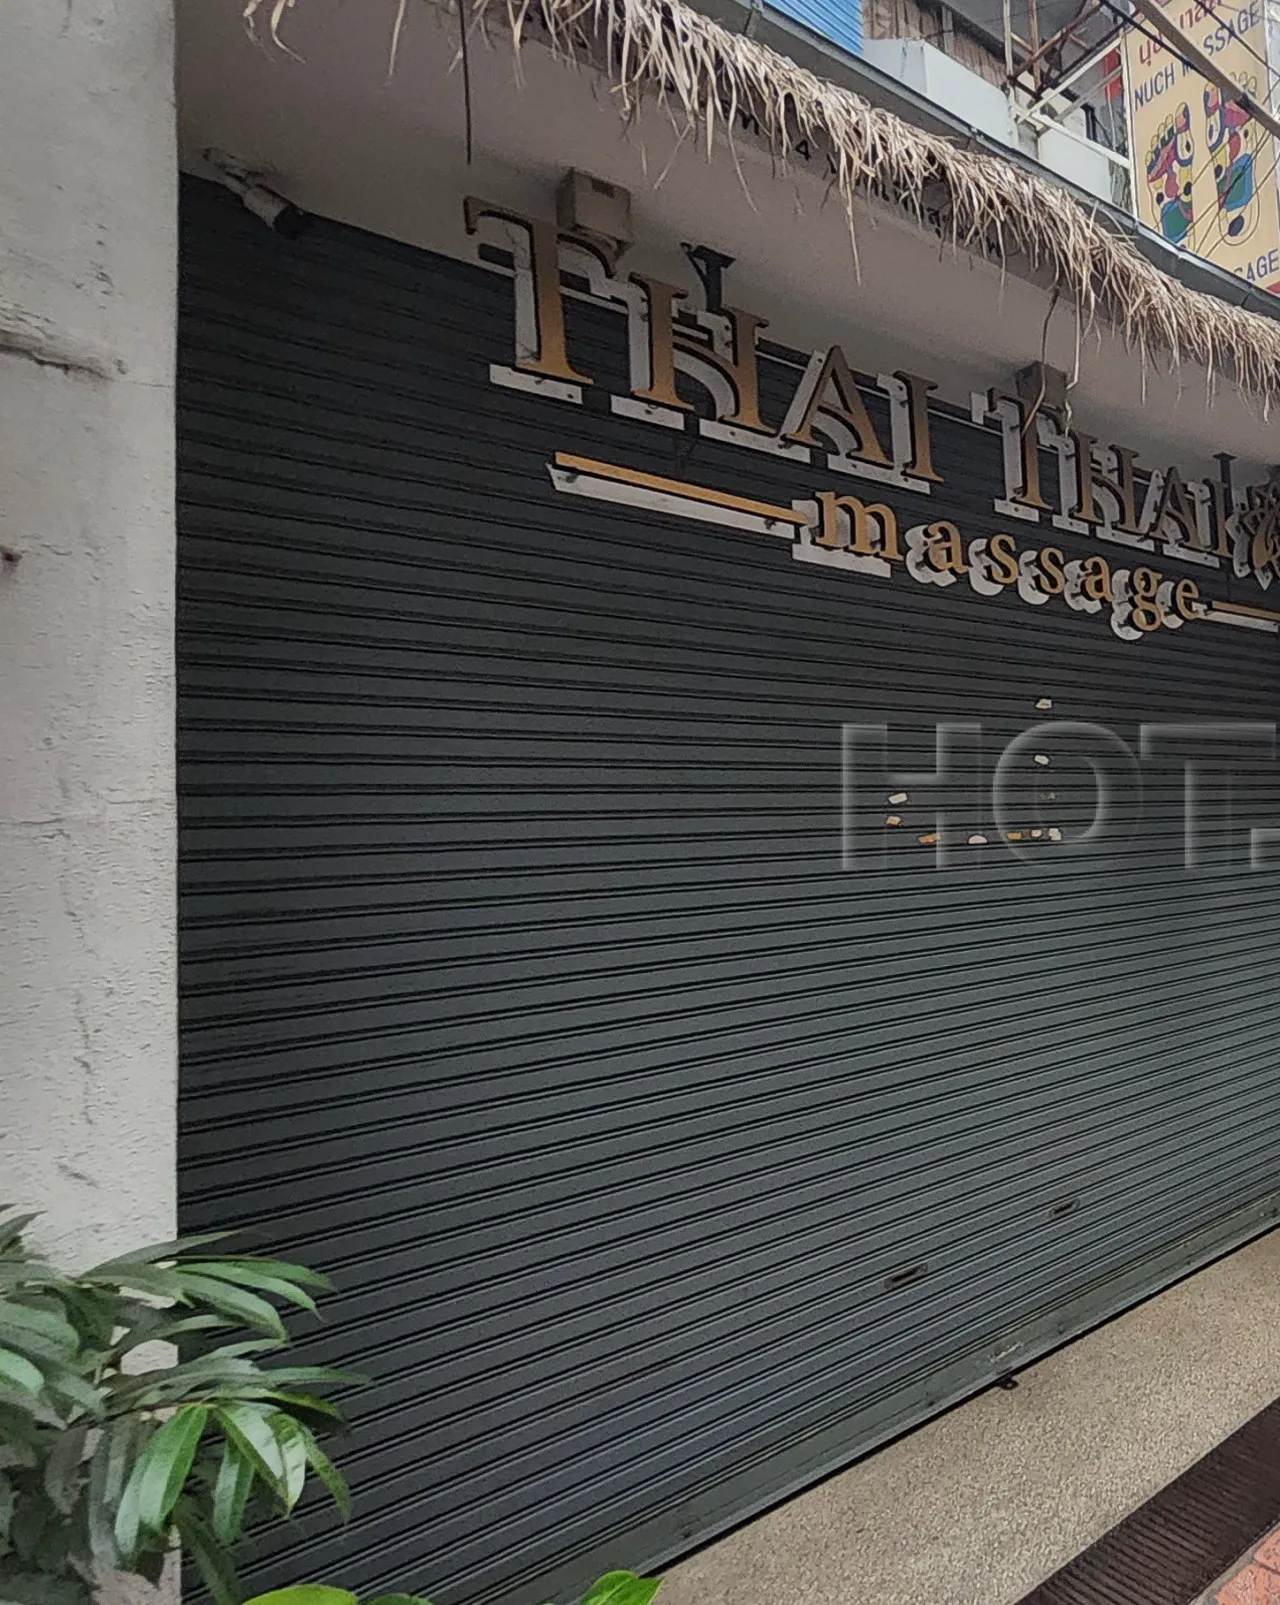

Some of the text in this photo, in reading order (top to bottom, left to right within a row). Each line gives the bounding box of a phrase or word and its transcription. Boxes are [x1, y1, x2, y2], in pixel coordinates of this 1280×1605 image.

[1134, 63, 1175, 112] NUCH
[464, 195, 1237, 558] THAI THAI
[815, 490, 1204, 631] massage
